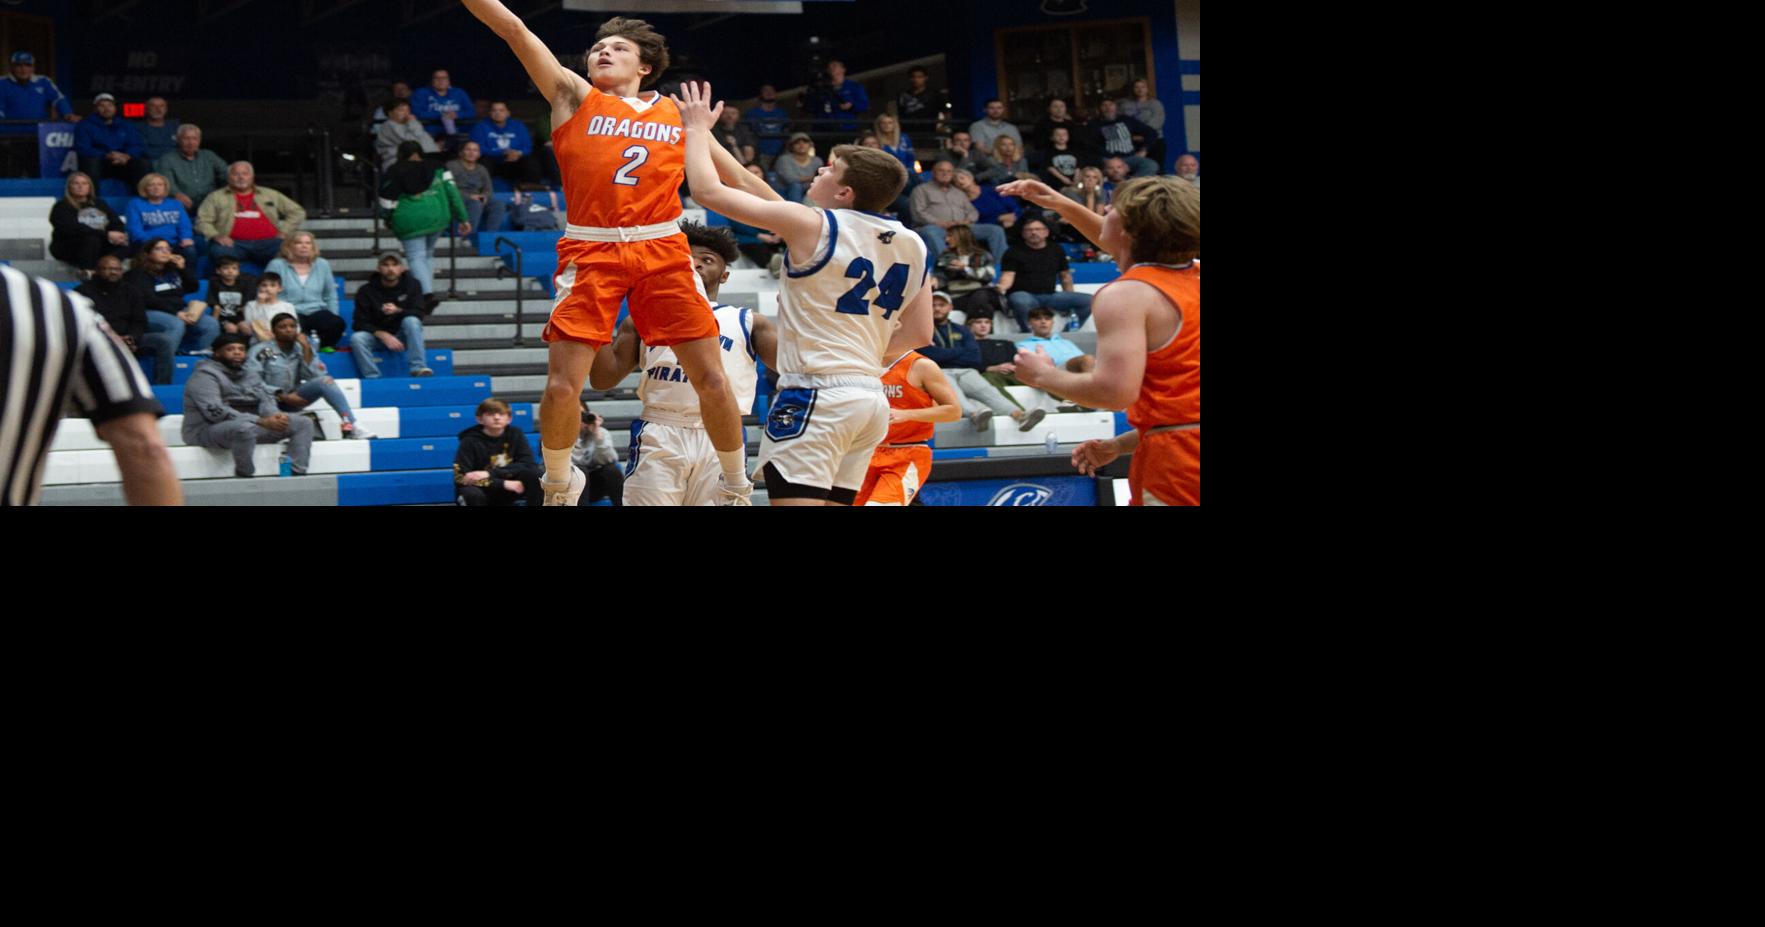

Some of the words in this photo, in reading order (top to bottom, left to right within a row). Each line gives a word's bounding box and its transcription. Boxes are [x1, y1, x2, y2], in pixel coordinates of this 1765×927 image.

[587, 115, 682, 145] DRAGONS
[612, 144, 650, 187] 2
[835, 256, 910, 320] 24
